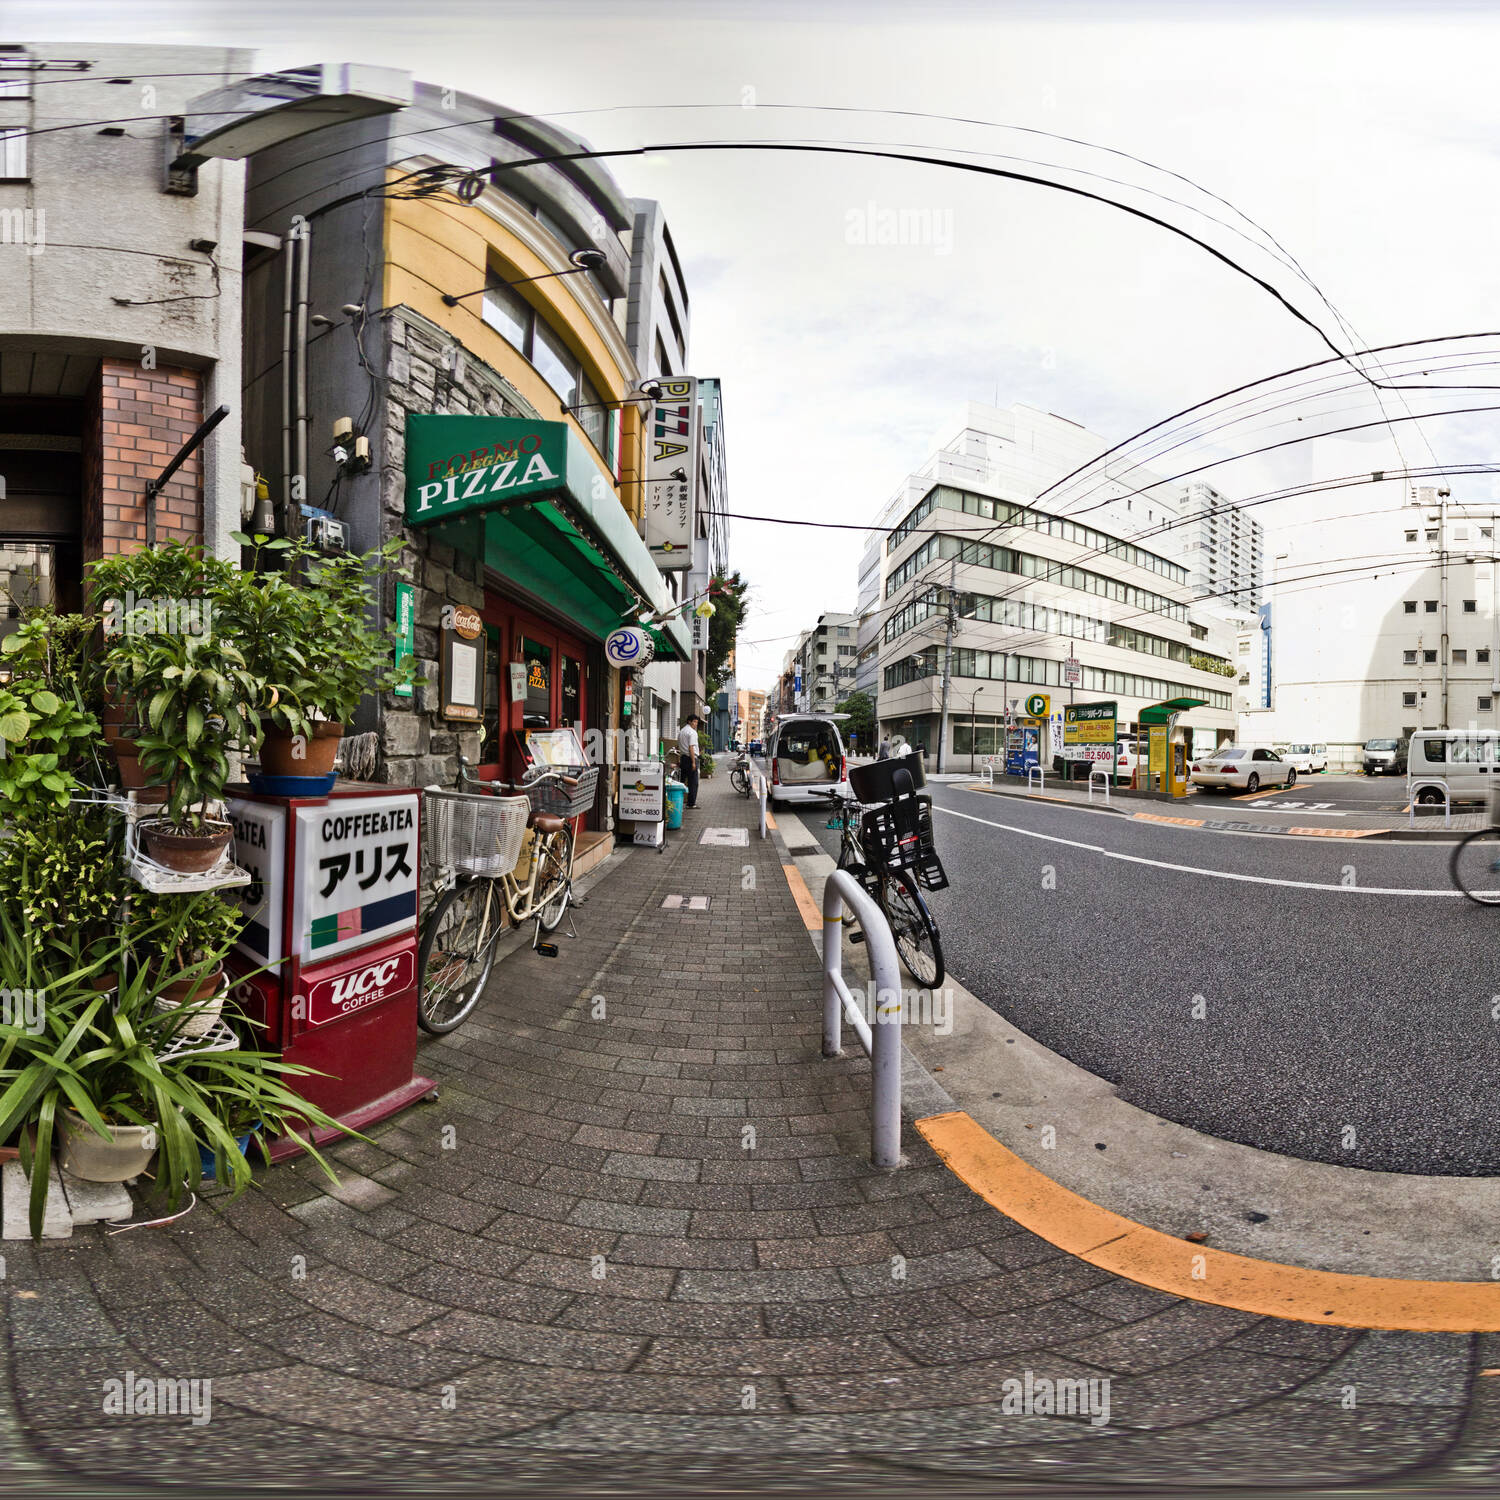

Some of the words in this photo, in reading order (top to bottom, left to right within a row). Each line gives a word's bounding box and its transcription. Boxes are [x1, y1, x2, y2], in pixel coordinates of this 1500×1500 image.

[654, 381, 690, 462] PIZZA
[427, 434, 543, 480] FORNO
[417, 453, 559, 512] PIZZA
[653, 486, 661, 510] ドリア
[529, 675, 546, 689] PIZZA
[1034, 699, 1043, 713] P
[1070, 712, 1076, 721] P
[322, 808, 413, 842] COFFEE&TEA
[319, 842, 412, 899] アリス
[342, 988, 385, 1011] COFFEE
